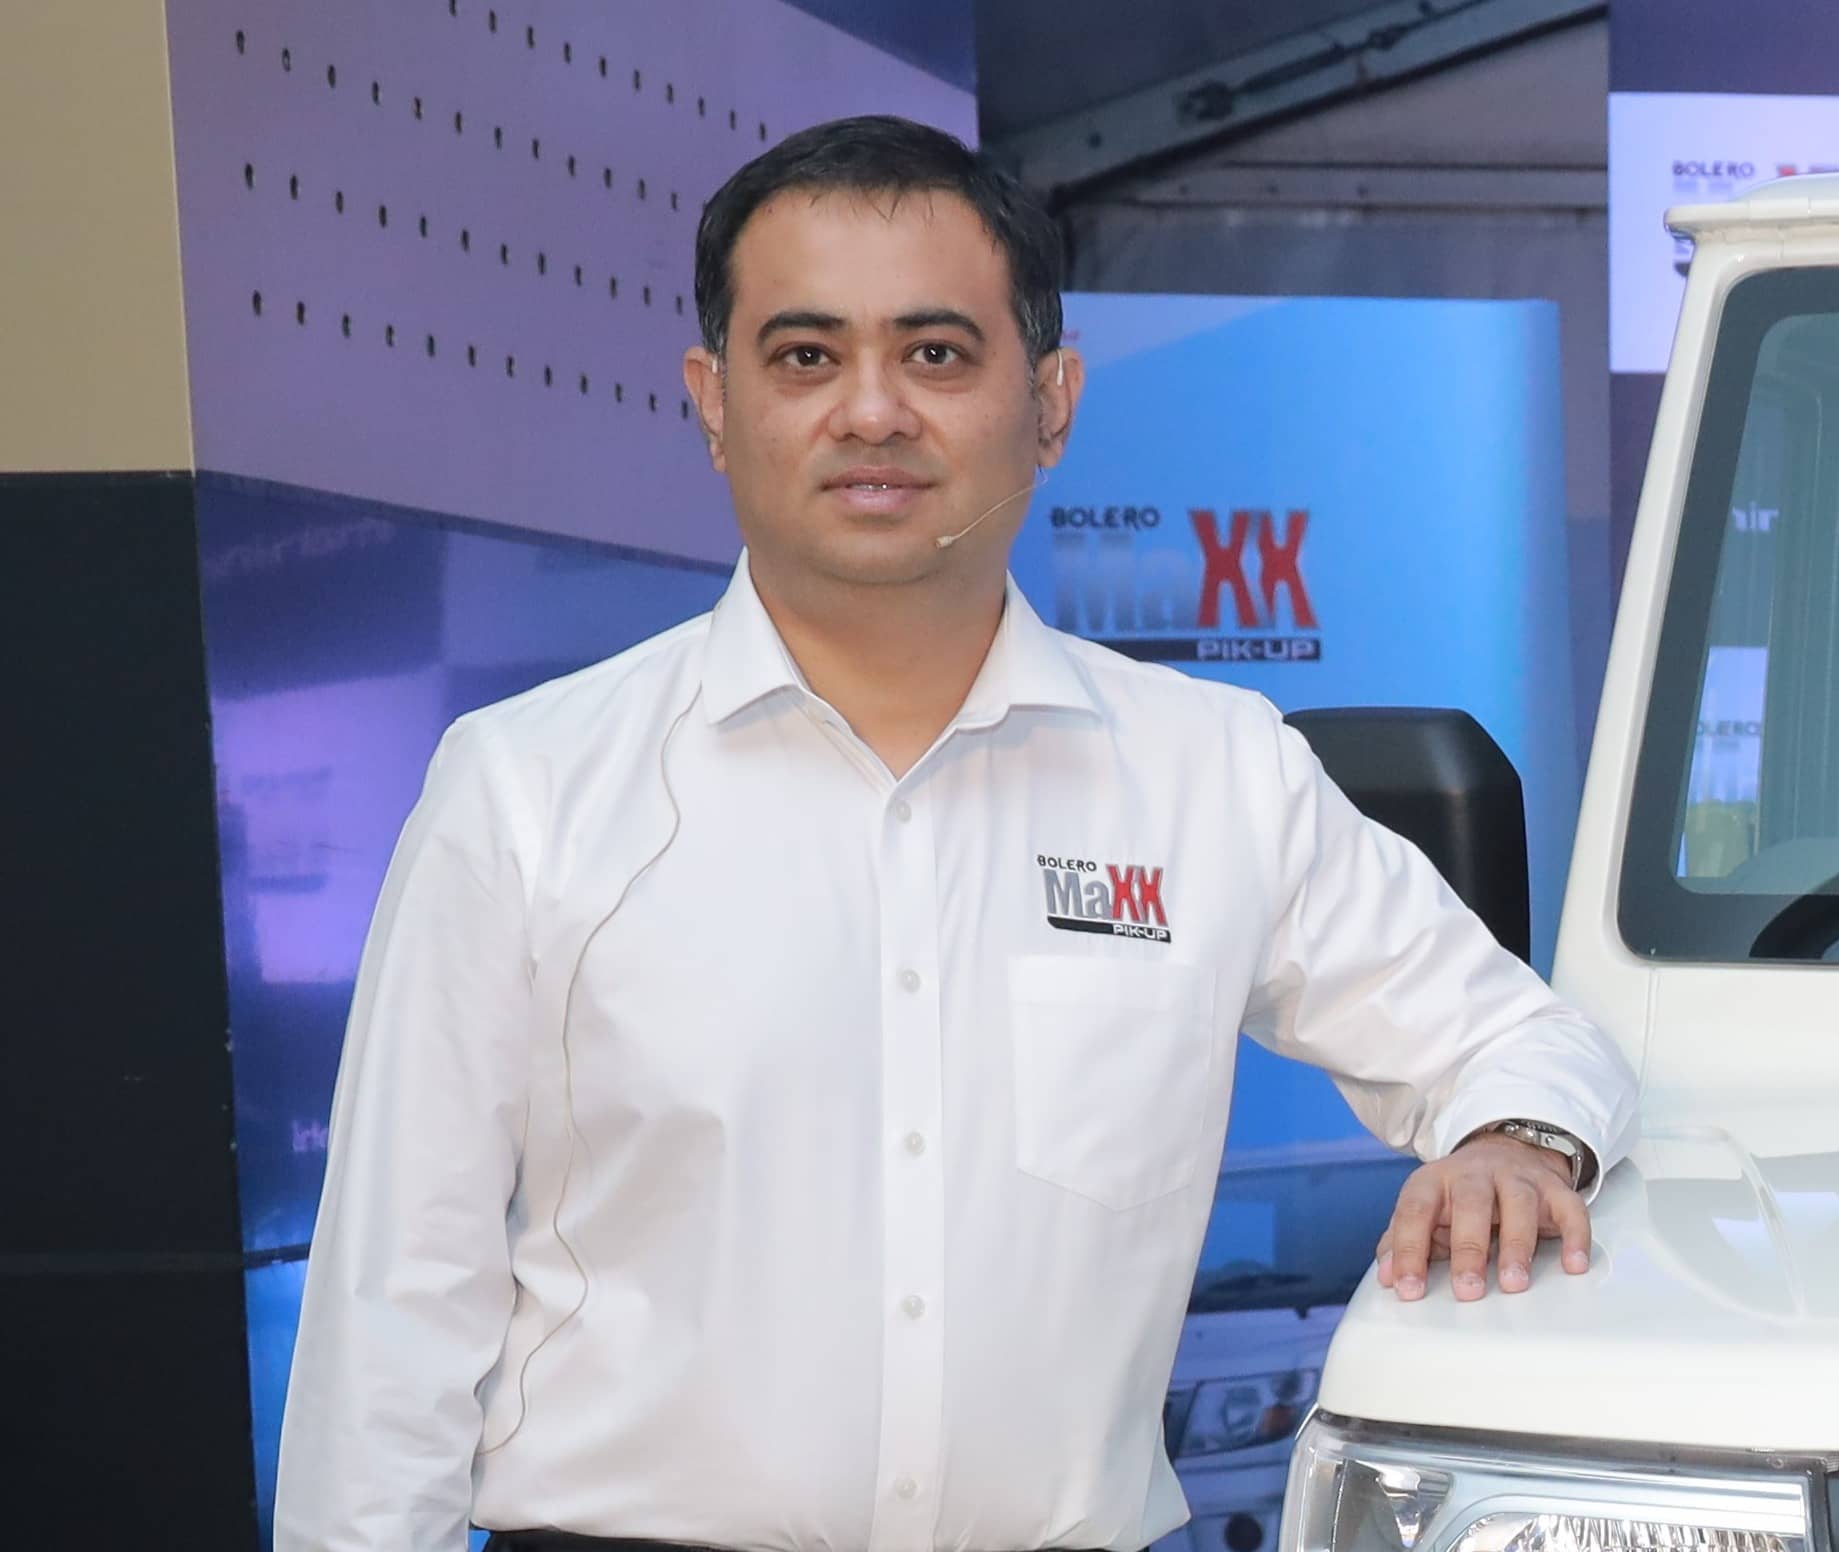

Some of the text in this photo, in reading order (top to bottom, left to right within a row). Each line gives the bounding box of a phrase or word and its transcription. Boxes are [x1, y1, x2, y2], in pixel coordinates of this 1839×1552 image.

[1672, 161, 1755, 177] BOLERO
[1051, 506, 1160, 529] BOLERO
[1198, 638, 1316, 661] PIK-UP
[1037, 854, 1097, 873] BOLERO
[1043, 863, 1169, 927] MaXX
[1113, 924, 1168, 942] PIK-UP
